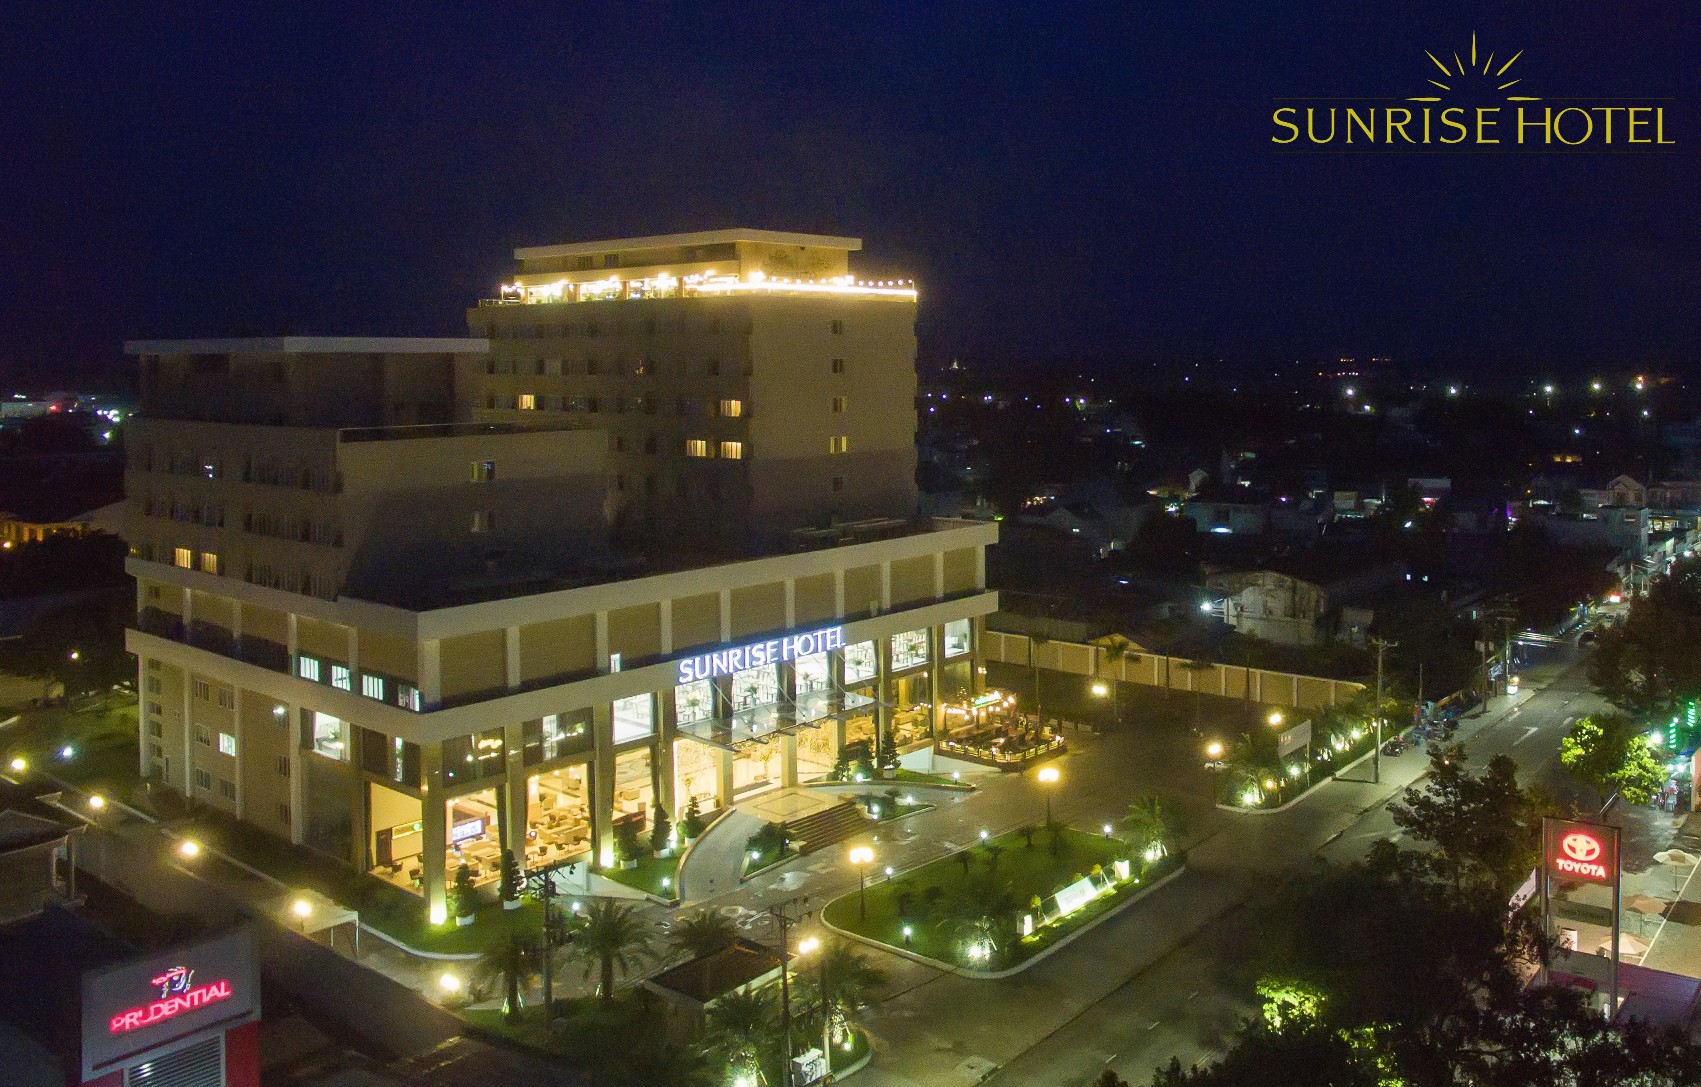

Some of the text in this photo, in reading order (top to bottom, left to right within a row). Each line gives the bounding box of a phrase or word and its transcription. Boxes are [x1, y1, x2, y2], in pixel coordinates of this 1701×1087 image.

[678, 626, 847, 684] SUNRISE HOTEL
[1556, 858, 1606, 878] TOYOTA
[110, 981, 232, 1031] PRUDENTIAL
